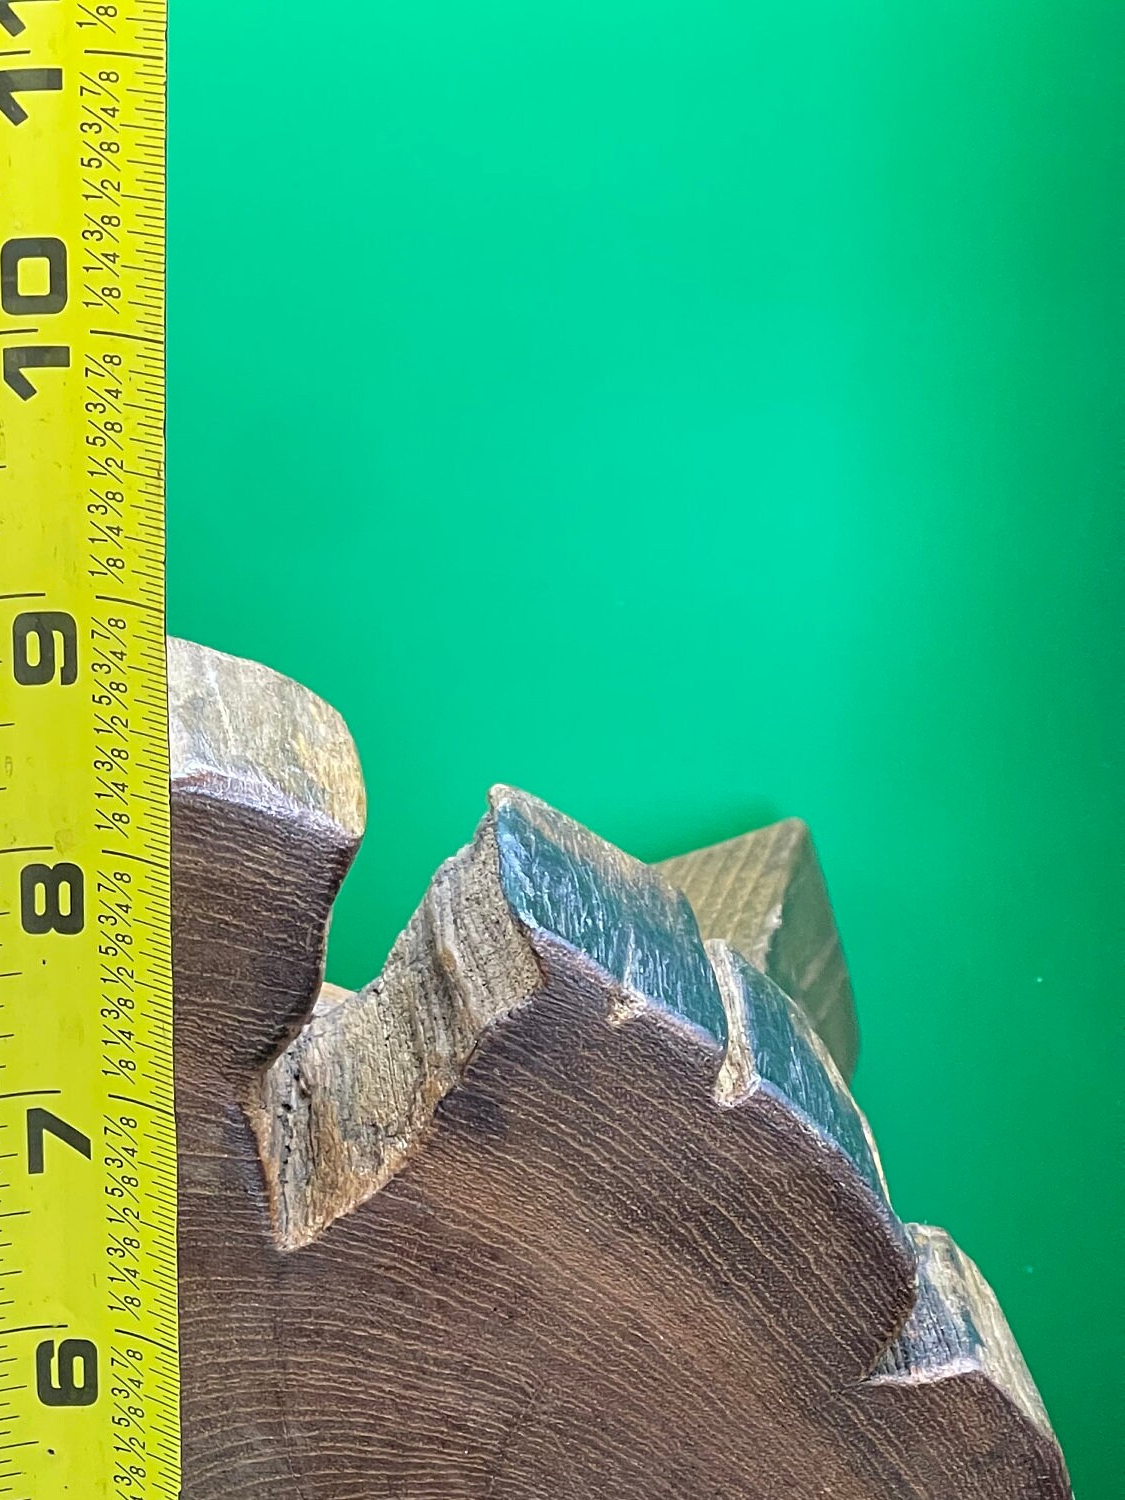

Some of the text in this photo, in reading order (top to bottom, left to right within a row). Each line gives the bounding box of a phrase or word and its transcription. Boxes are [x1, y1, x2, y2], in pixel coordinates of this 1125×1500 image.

[75, 3, 117, 33] 1/8
[78, 70, 119, 103] 7/8
[79, 104, 119, 134] 3/4
[79, 140, 121, 171] 5/8
[81, 178, 120, 206] 1/2
[81, 212, 120, 243] 3/8
[82, 247, 120, 278] 1/4
[81, 283, 121, 314] 1/8
[0, 237, 70, 401] 10
[84, 353, 122, 385] 7/8
[84, 385, 122, 414] 3/4
[85, 419, 123, 451] 5/8
[86, 455, 126, 484] 1/2
[86, 488, 124, 517] 3/8
[87, 520, 123, 549] 1/4
[87, 553, 125, 584] 1/8
[90, 616, 127, 648] 7/8
[13, 611, 78, 686] 9
[90, 646, 127, 675] 3/4
[91, 678, 128, 710] 5/8
[92, 713, 128, 742] 1/2
[93, 745, 129, 775] 3/8
[93, 776, 128, 806] 1/4
[93, 808, 130, 838] 1/8
[21, 863, 85, 935] 8
[96, 870, 132, 901] 7/8
[97, 898, 132, 927] 3/4
[98, 930, 134, 962] 5/8
[99, 963, 134, 992] 1/2
[99, 993, 134, 1023] 3/8
[101, 1023, 135, 1053] 1/4
[101, 1054, 136, 1084] 1/8
[27, 1108, 91, 1174] 7
[102, 1114, 138, 1145] 7/8
[104, 1142, 138, 1171] 3/4
[104, 1171, 139, 1203] 5/8
[105, 1203, 139, 1233] 1/2
[105, 1232, 140, 1262] 3/8
[106, 1261, 140, 1290] 1/4
[107, 1290, 141, 1320] 1/8
[36, 1339, 98, 1407] 6
[110, 1345, 144, 1377] 7/8
[110, 1372, 143, 1401] 3/4
[111, 1401, 145, 1434] 5/8
[112, 1432, 145, 1462] 1/2
[112, 1460, 146, 1491] 3/8
